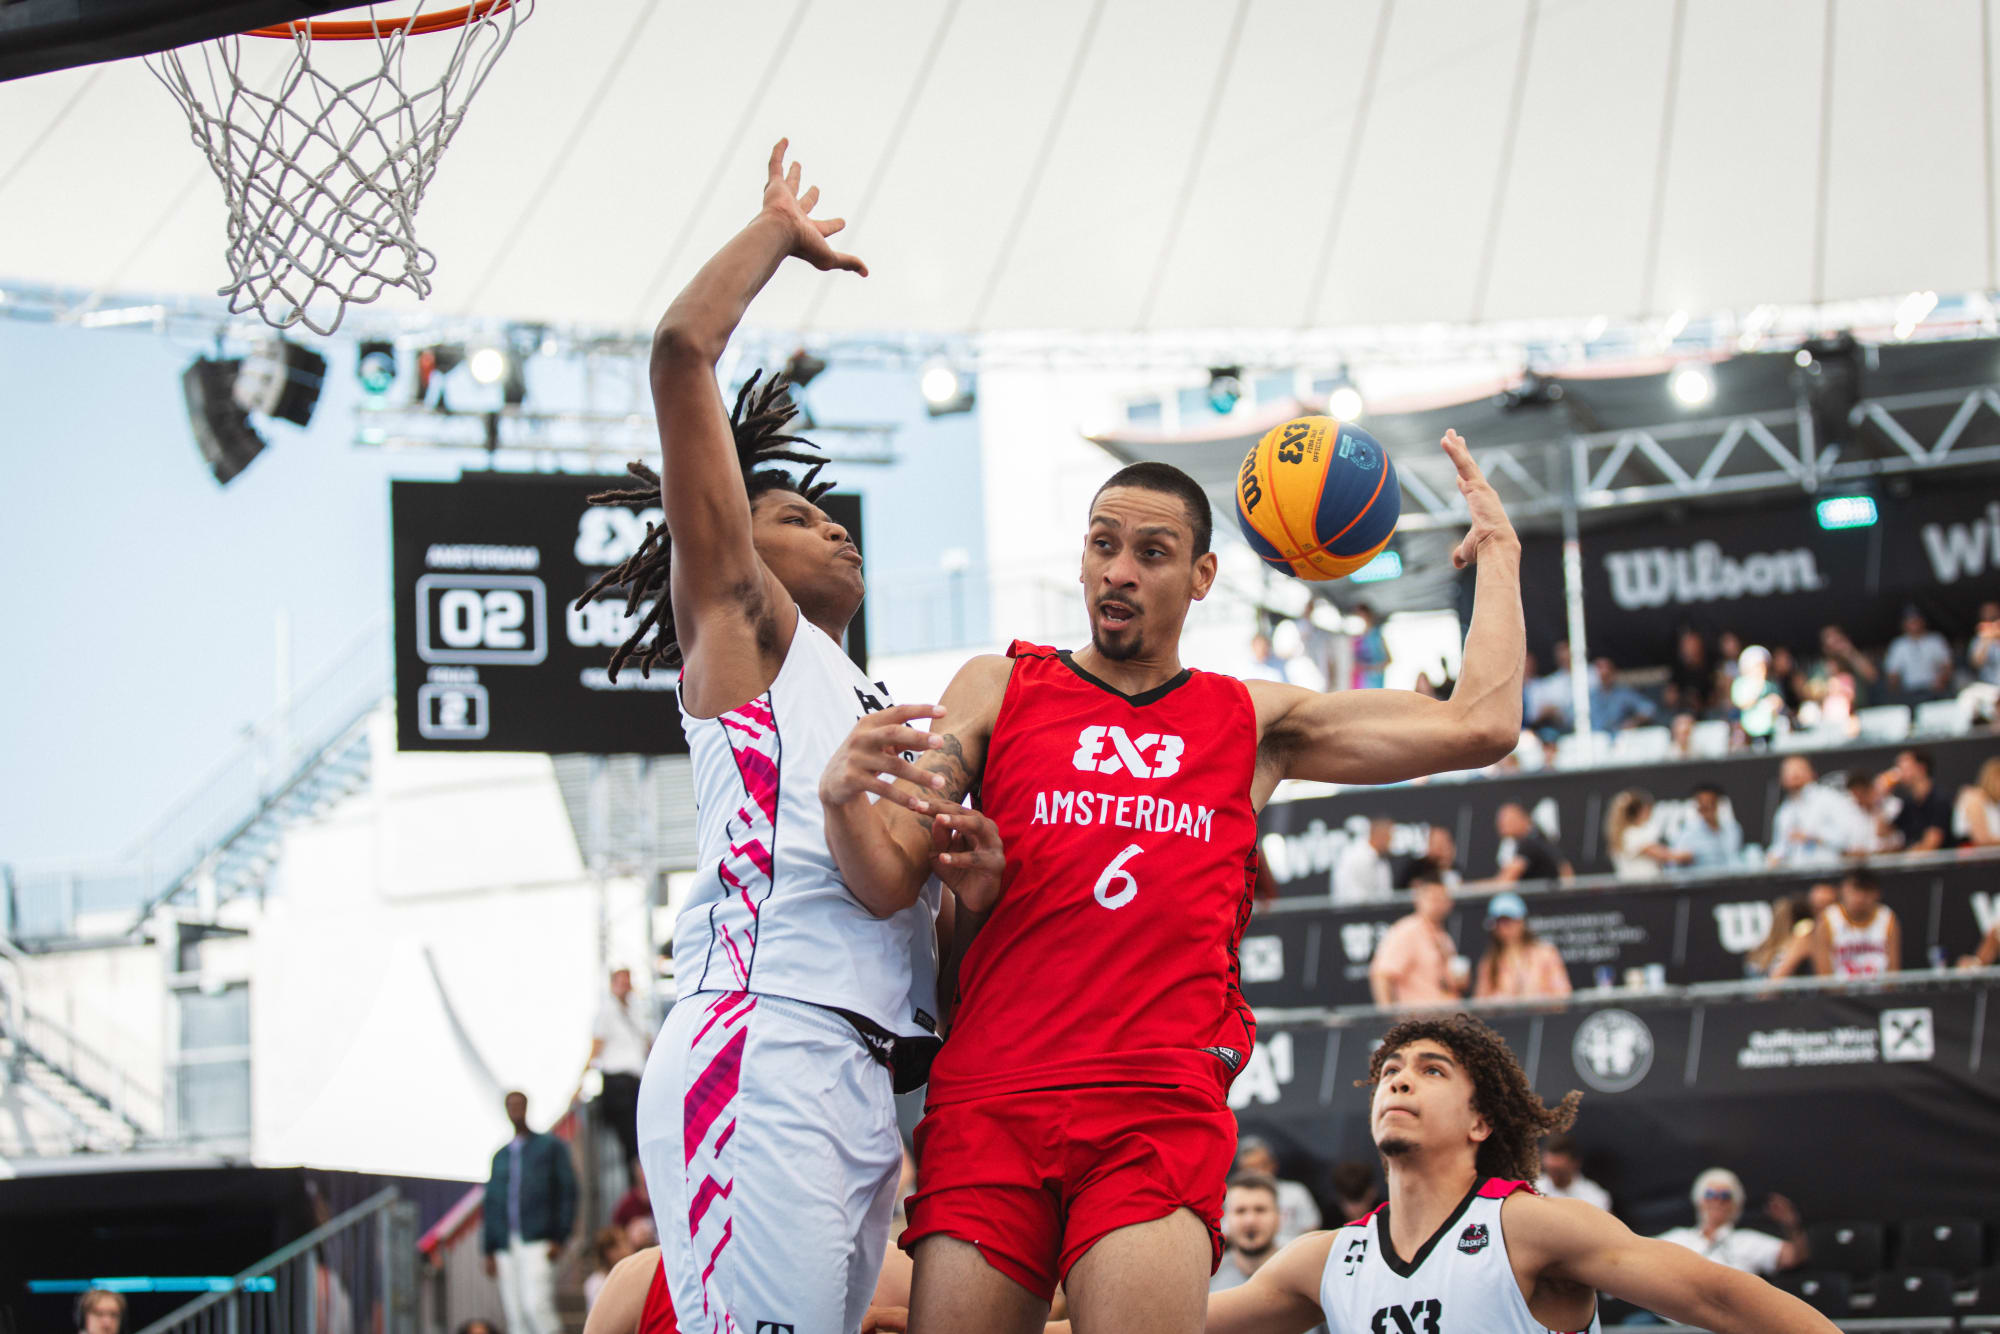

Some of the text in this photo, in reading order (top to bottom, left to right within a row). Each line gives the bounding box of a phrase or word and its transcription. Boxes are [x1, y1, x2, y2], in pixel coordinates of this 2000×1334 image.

[1602, 540, 1824, 611] Wilson
[439, 588, 527, 648] 02
[440, 690, 468, 730] 2
[1072, 725, 1185, 779] 3X3
[1031, 790, 1215, 843] AMSTERDAM
[1093, 843, 1144, 911] 6
